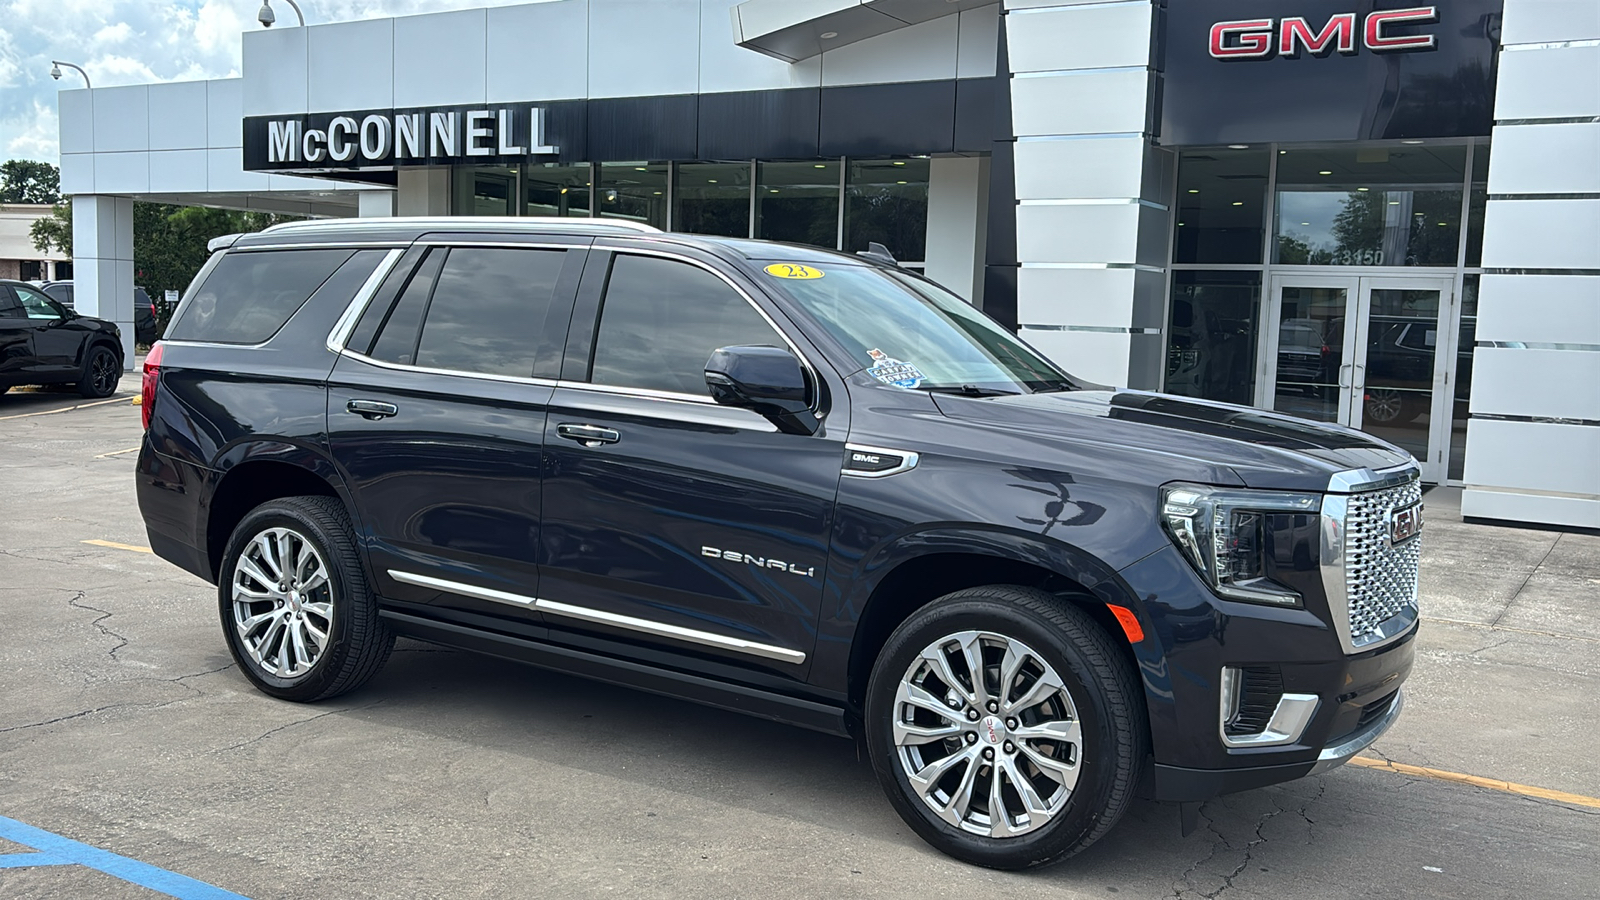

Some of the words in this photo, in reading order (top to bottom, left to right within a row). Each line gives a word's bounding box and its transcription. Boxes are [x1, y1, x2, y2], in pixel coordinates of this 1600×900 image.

[1208, 6, 1438, 58] GMC
[268, 107, 560, 163] McCONNELL
[781, 265, 809, 277] 23
[871, 364, 916, 377] CARFAX
[852, 453, 880, 464] GMC
[701, 545, 815, 577] DENALI
[986, 718, 997, 743] GMC
